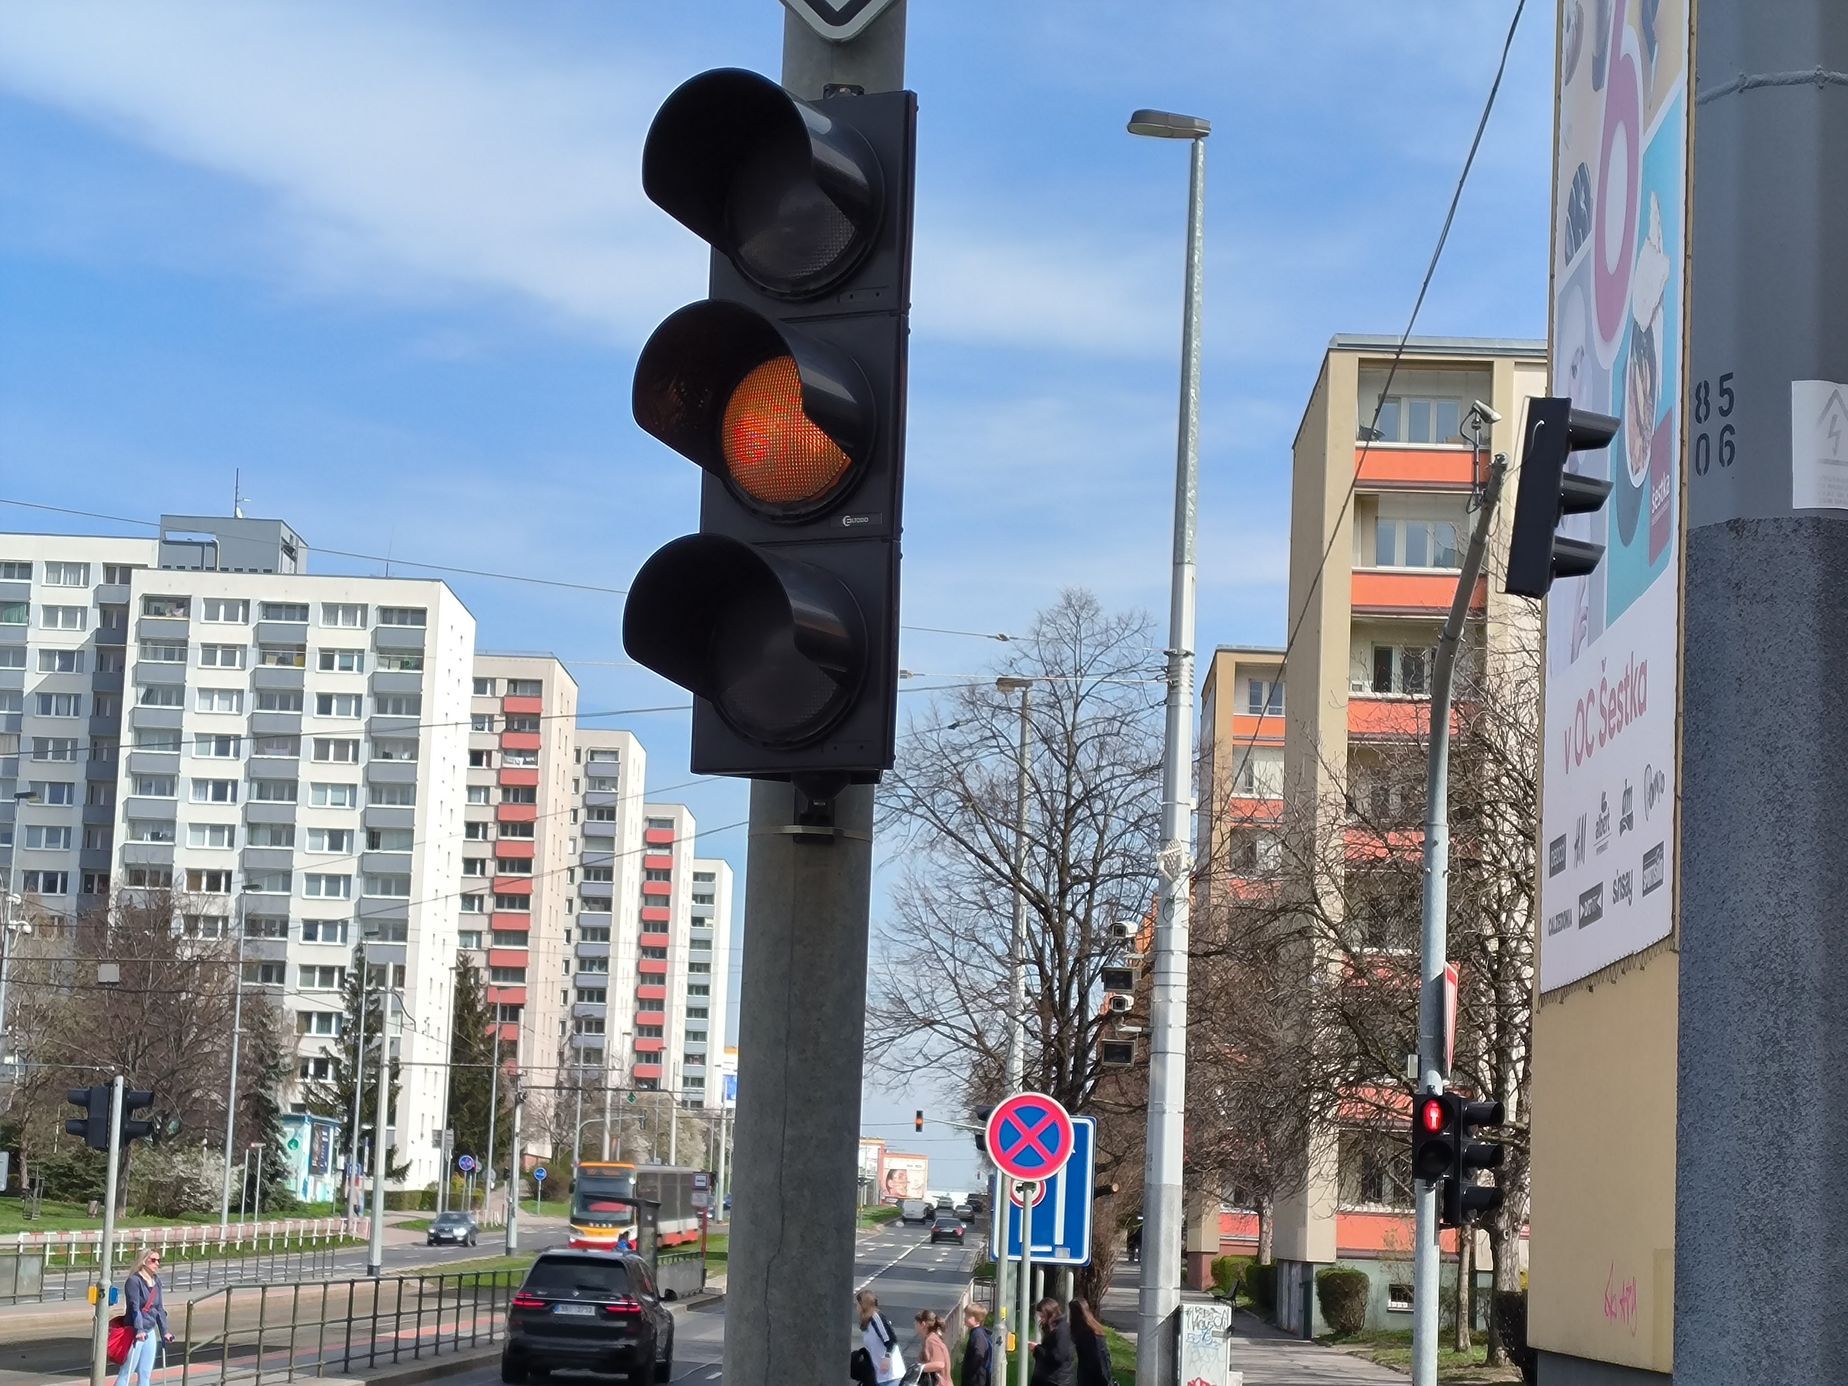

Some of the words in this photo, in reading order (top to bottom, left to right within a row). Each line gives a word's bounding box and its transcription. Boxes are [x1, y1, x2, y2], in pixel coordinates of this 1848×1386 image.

[1695, 372, 1734, 424] 85
[1695, 424, 1736, 476] 06
[1564, 726, 1572, 774] v
[1574, 688, 1595, 767] OC
[1599, 651, 1648, 748] Šestka
